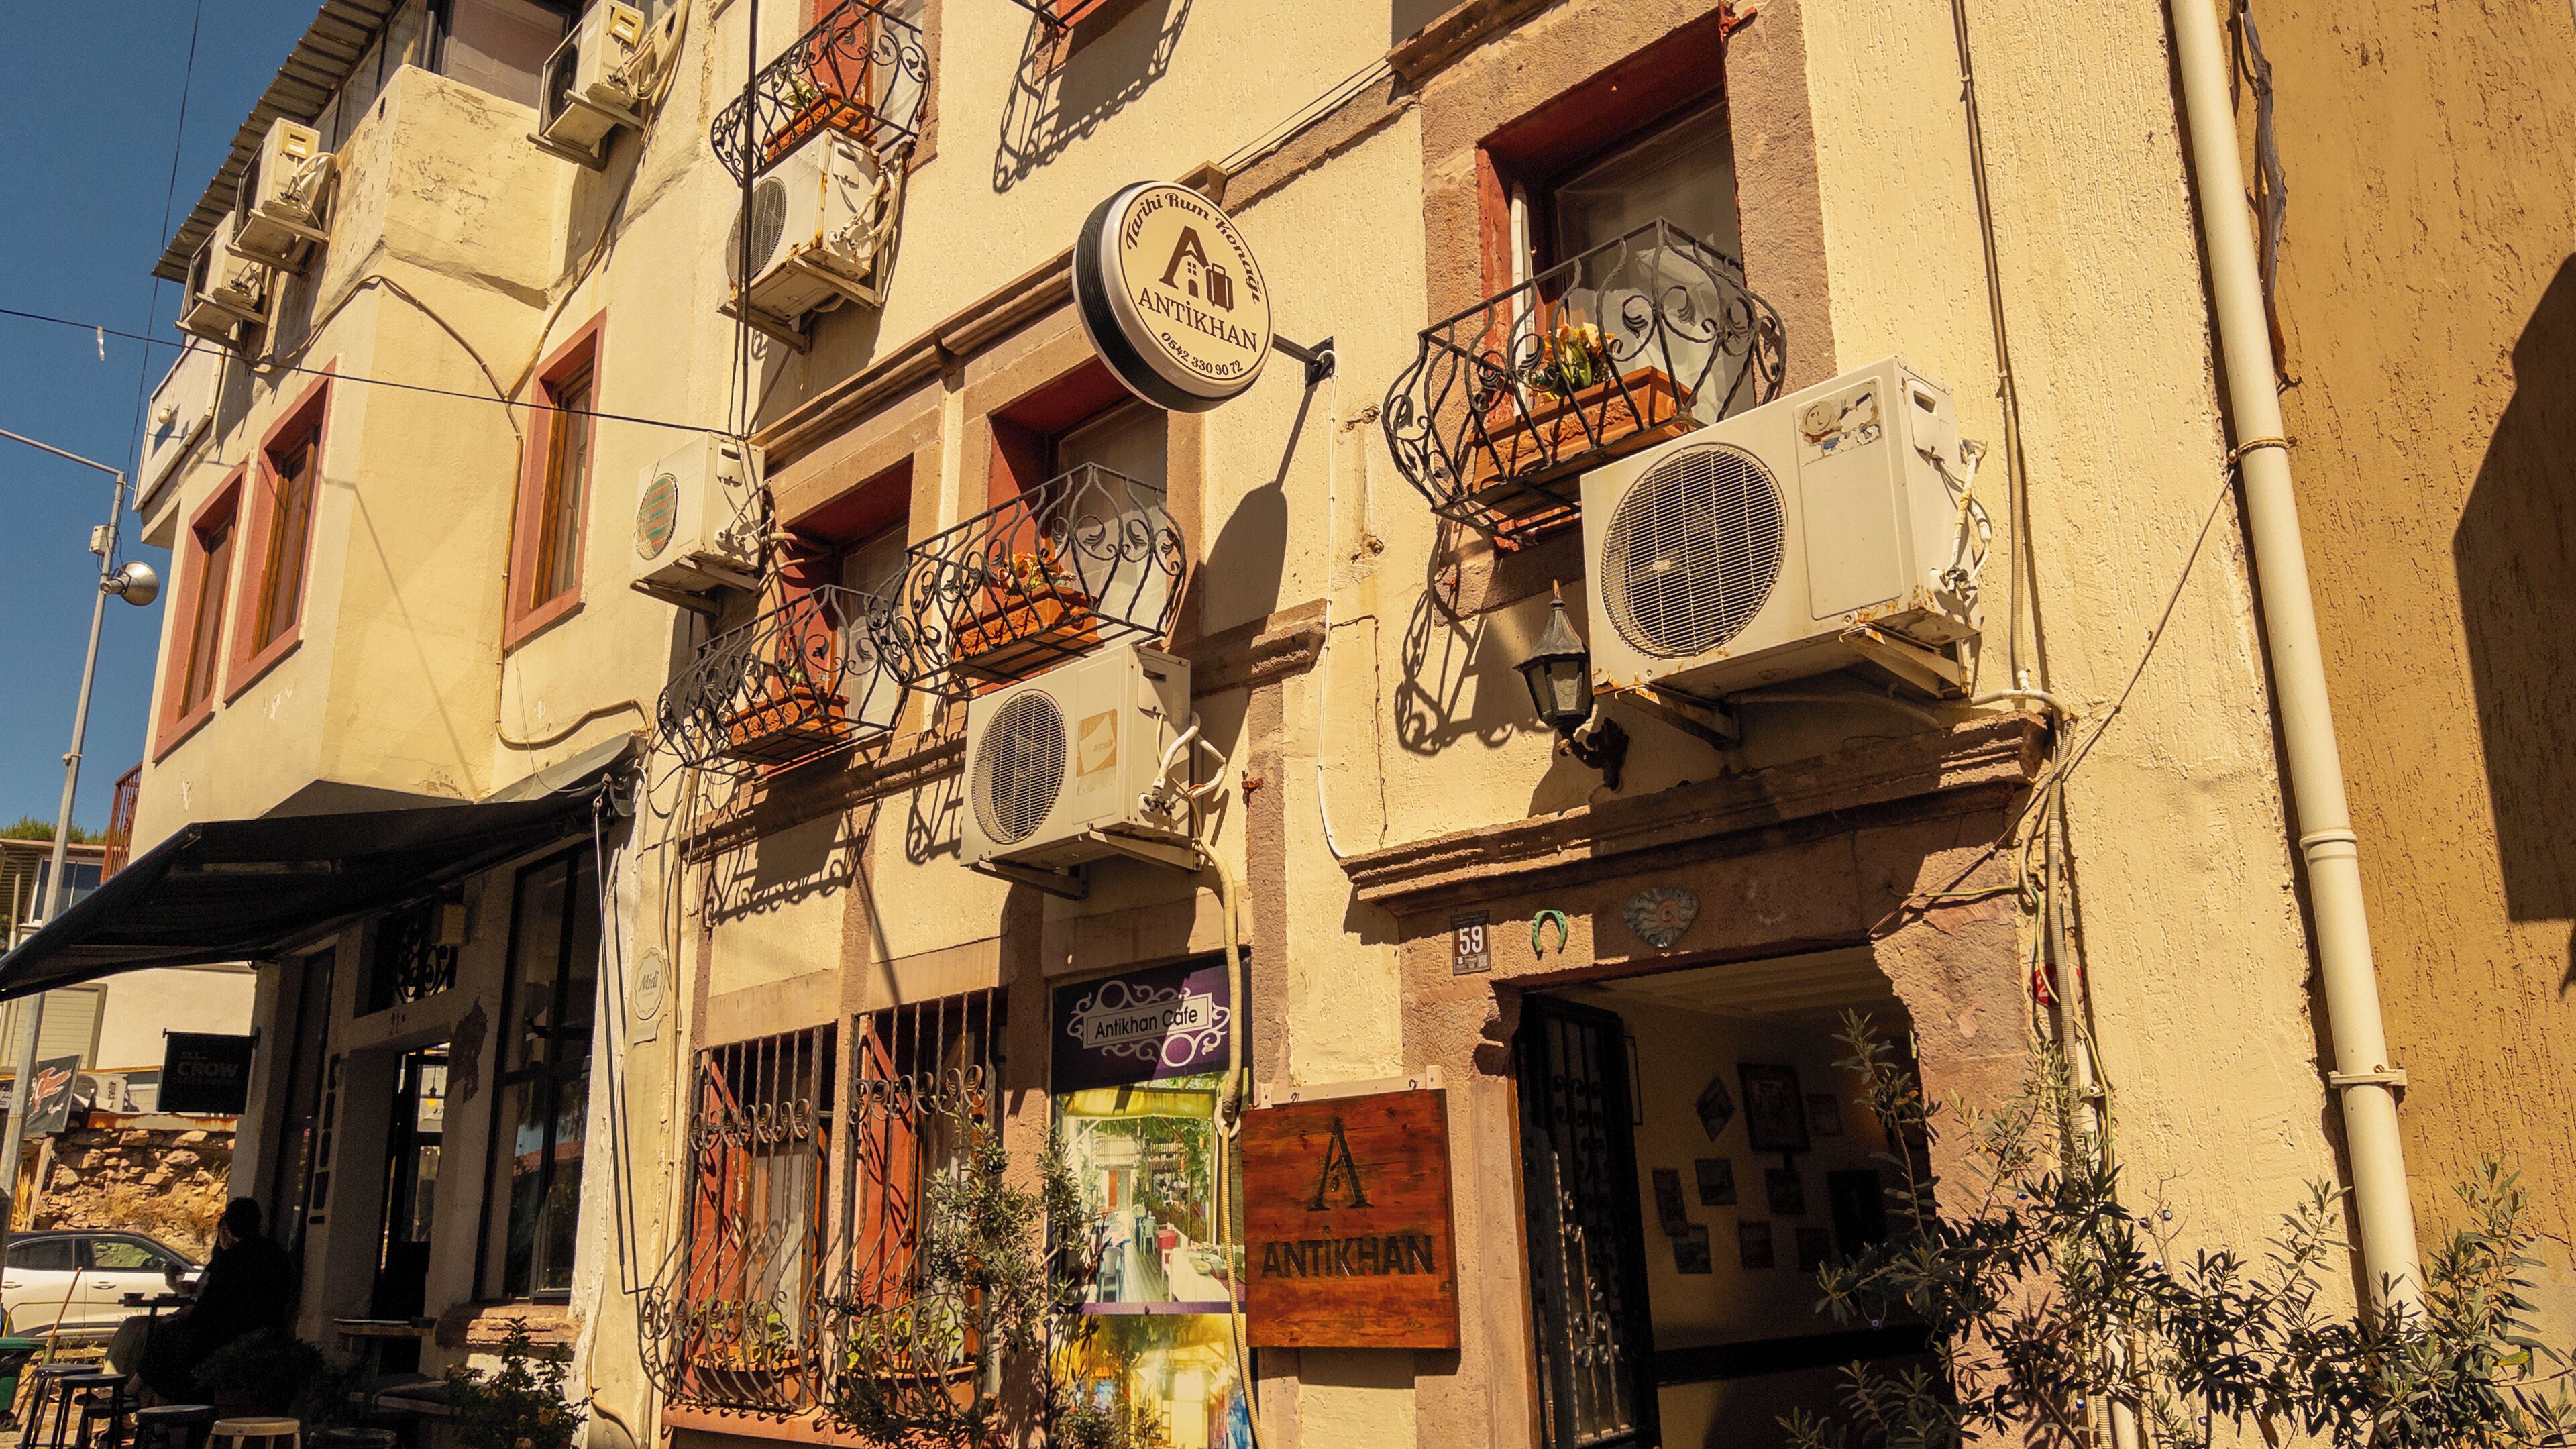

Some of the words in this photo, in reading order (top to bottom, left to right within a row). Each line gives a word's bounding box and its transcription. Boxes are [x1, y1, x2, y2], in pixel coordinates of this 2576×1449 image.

[1126, 194, 1163, 250] Tarihi
[1165, 193, 1209, 221] Rum
[1215, 217, 1262, 305] Konağı
[1138, 287, 1257, 352] ANTİKHAN
[1161, 332, 1189, 362] 0542
[1191, 356, 1214, 374] 330
[1216, 363, 1229, 376] 90
[1229, 360, 1244, 374] 72
[1459, 926, 1483, 955] 59
[637, 970, 659, 993] Midi
[1095, 1016, 1157, 1039] Antikhan
[1162, 1006, 1198, 1027] Cafe
[177, 1061, 239, 1077] CROW
